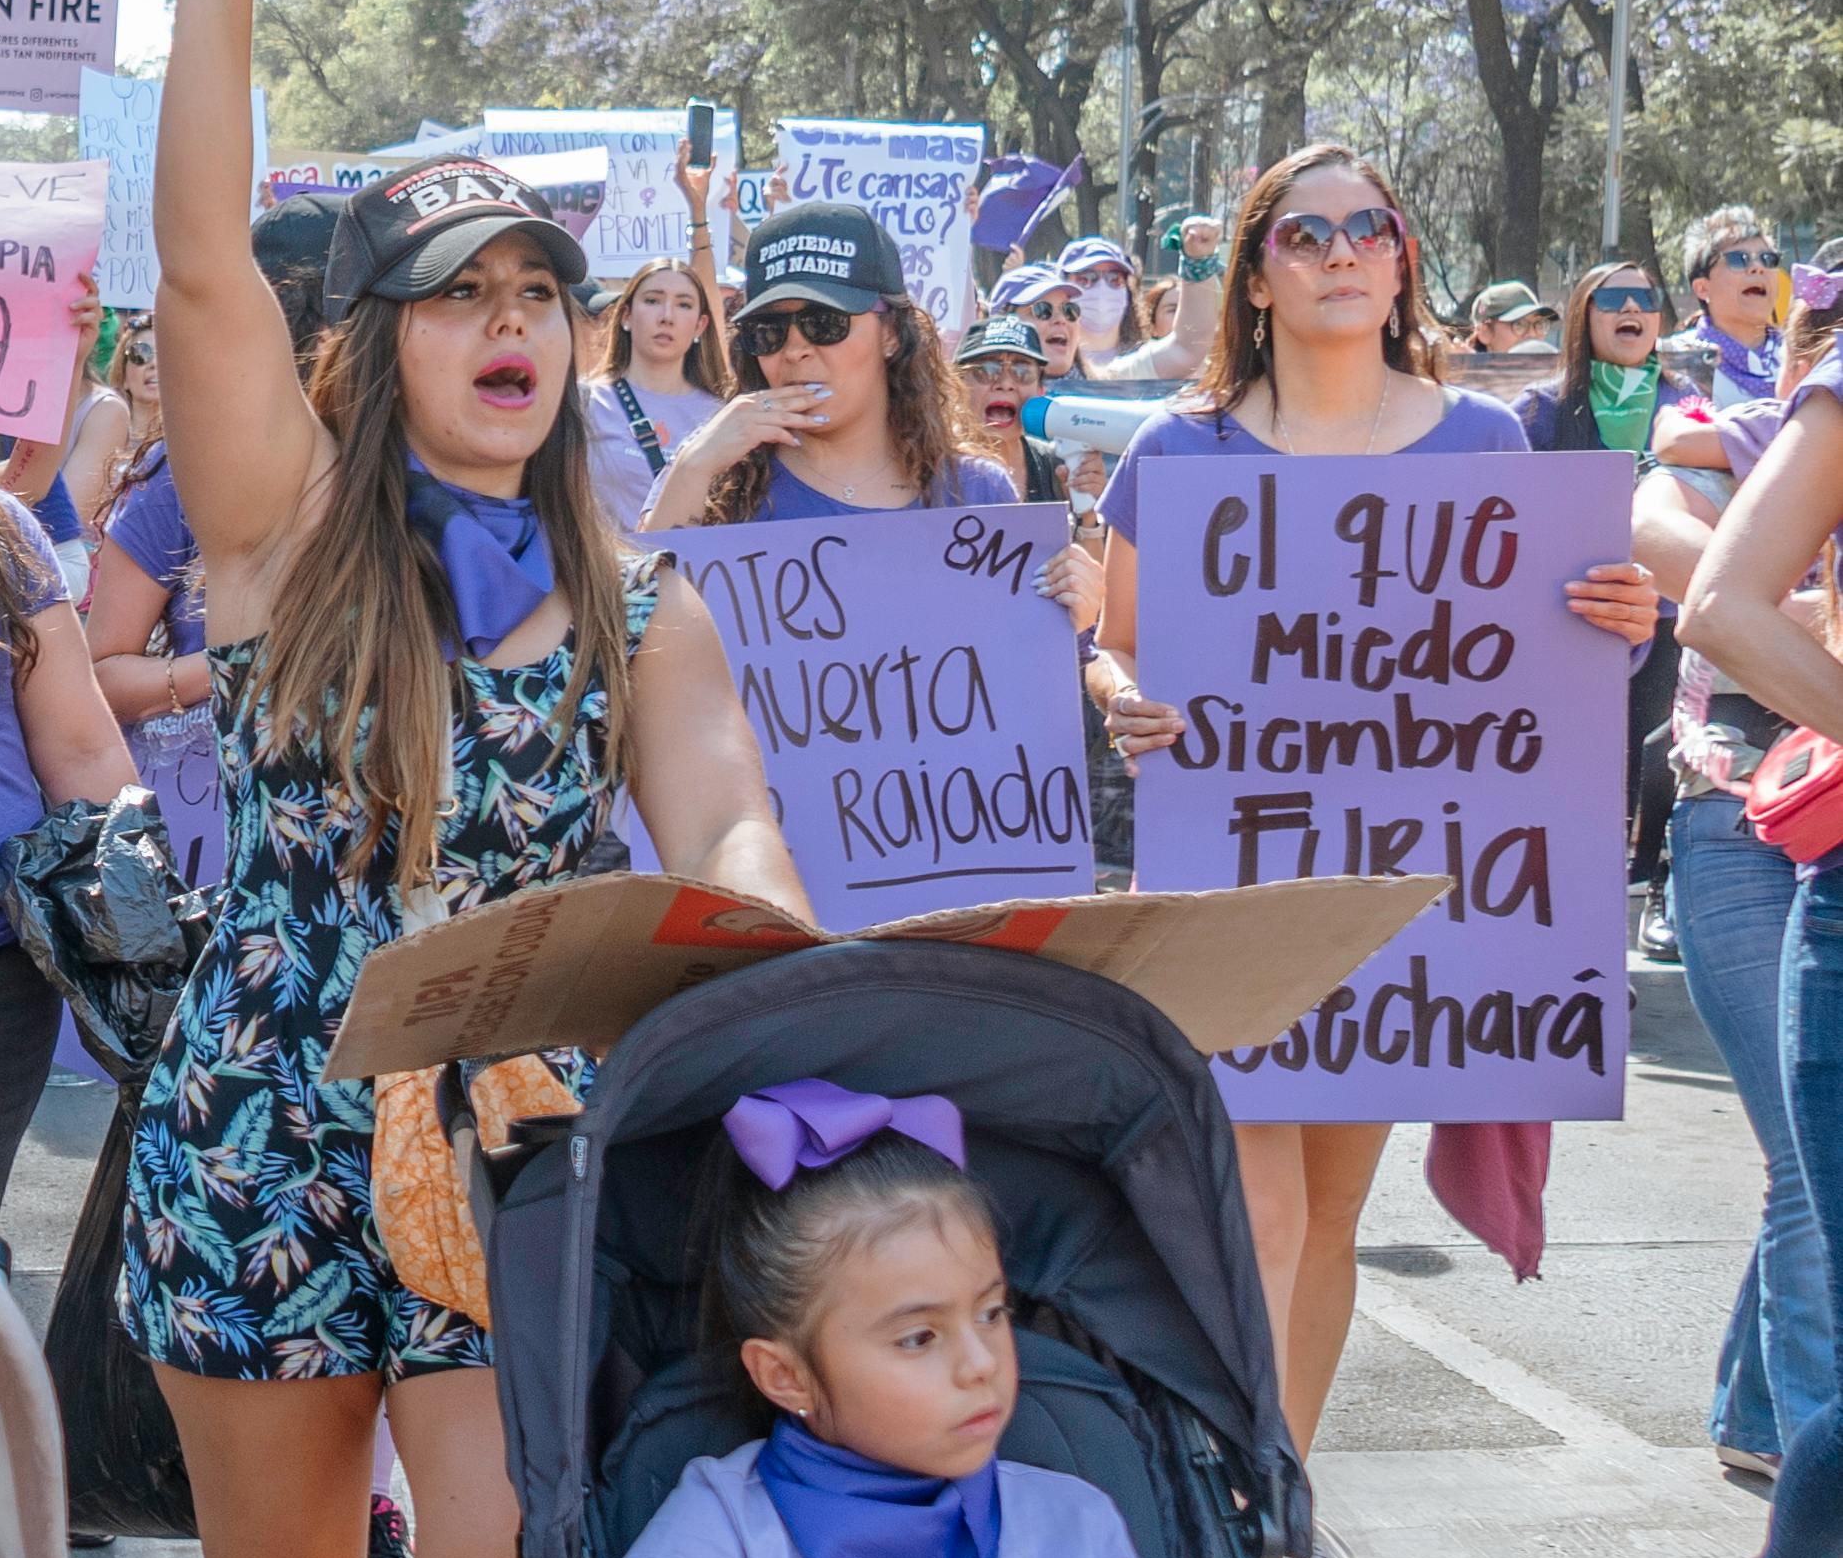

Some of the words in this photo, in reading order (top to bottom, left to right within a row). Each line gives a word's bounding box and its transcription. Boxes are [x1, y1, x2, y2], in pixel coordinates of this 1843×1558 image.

[12, 49, 32, 60] TAN
[34, 50, 98, 63] INDIFERENTE
[22, 36, 79, 49] DIFERENTES
[83, 114, 126, 149] POR
[491, 132, 547, 156] UNOS
[620, 132, 657, 155] CON
[388, 190, 408, 204] TE
[406, 172, 442, 195] HACE
[410, 175, 532, 219] BAX
[858, 172, 966, 203] cansas
[759, 234, 857, 264] PROPIEDAD
[765, 262, 786, 281] DE
[788, 255, 850, 280] NADIE
[944, 514, 1034, 595] 8M
[1203, 473, 1277, 598] el
[1335, 492, 1519, 608] que
[1251, 599, 1516, 694] Miedo
[1169, 692, 1544, 775] Siembre
[1214, 953, 1608, 1079] sechará
